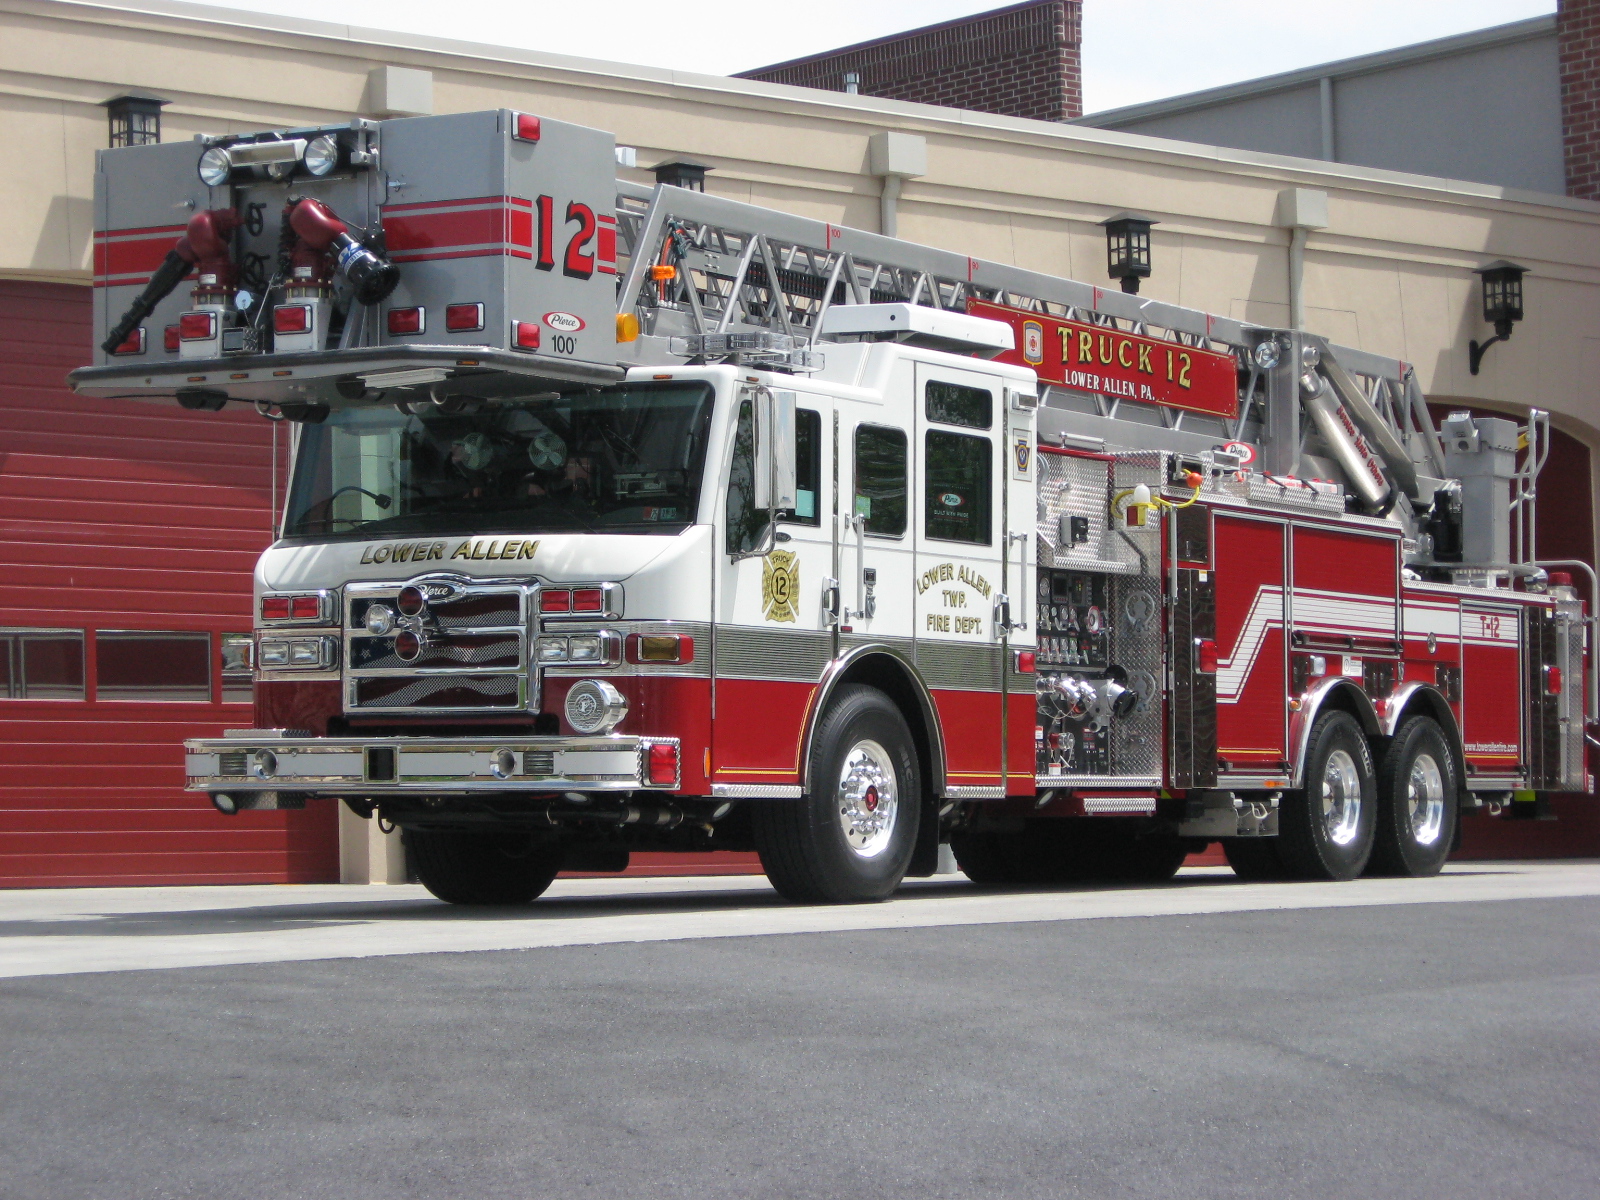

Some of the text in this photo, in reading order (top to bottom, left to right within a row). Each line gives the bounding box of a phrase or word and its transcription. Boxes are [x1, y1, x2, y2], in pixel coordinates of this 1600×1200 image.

[535, 194, 595, 280] 12
[831, 229, 841, 238] 100
[550, 313, 577, 328] Pierce
[1057, 326, 1192, 390] TRUCK 12
[1064, 369, 1155, 401] LOWER ALLEN, PA.
[360, 540, 541, 565] LOWER ALLEN
[776, 576, 786, 596] 12
[916, 562, 992, 600] LOWER ALLEN
[942, 589, 967, 608] TWP.
[927, 614, 982, 634] FIRE DEPT.
[1480, 615, 1500, 638] T-12
